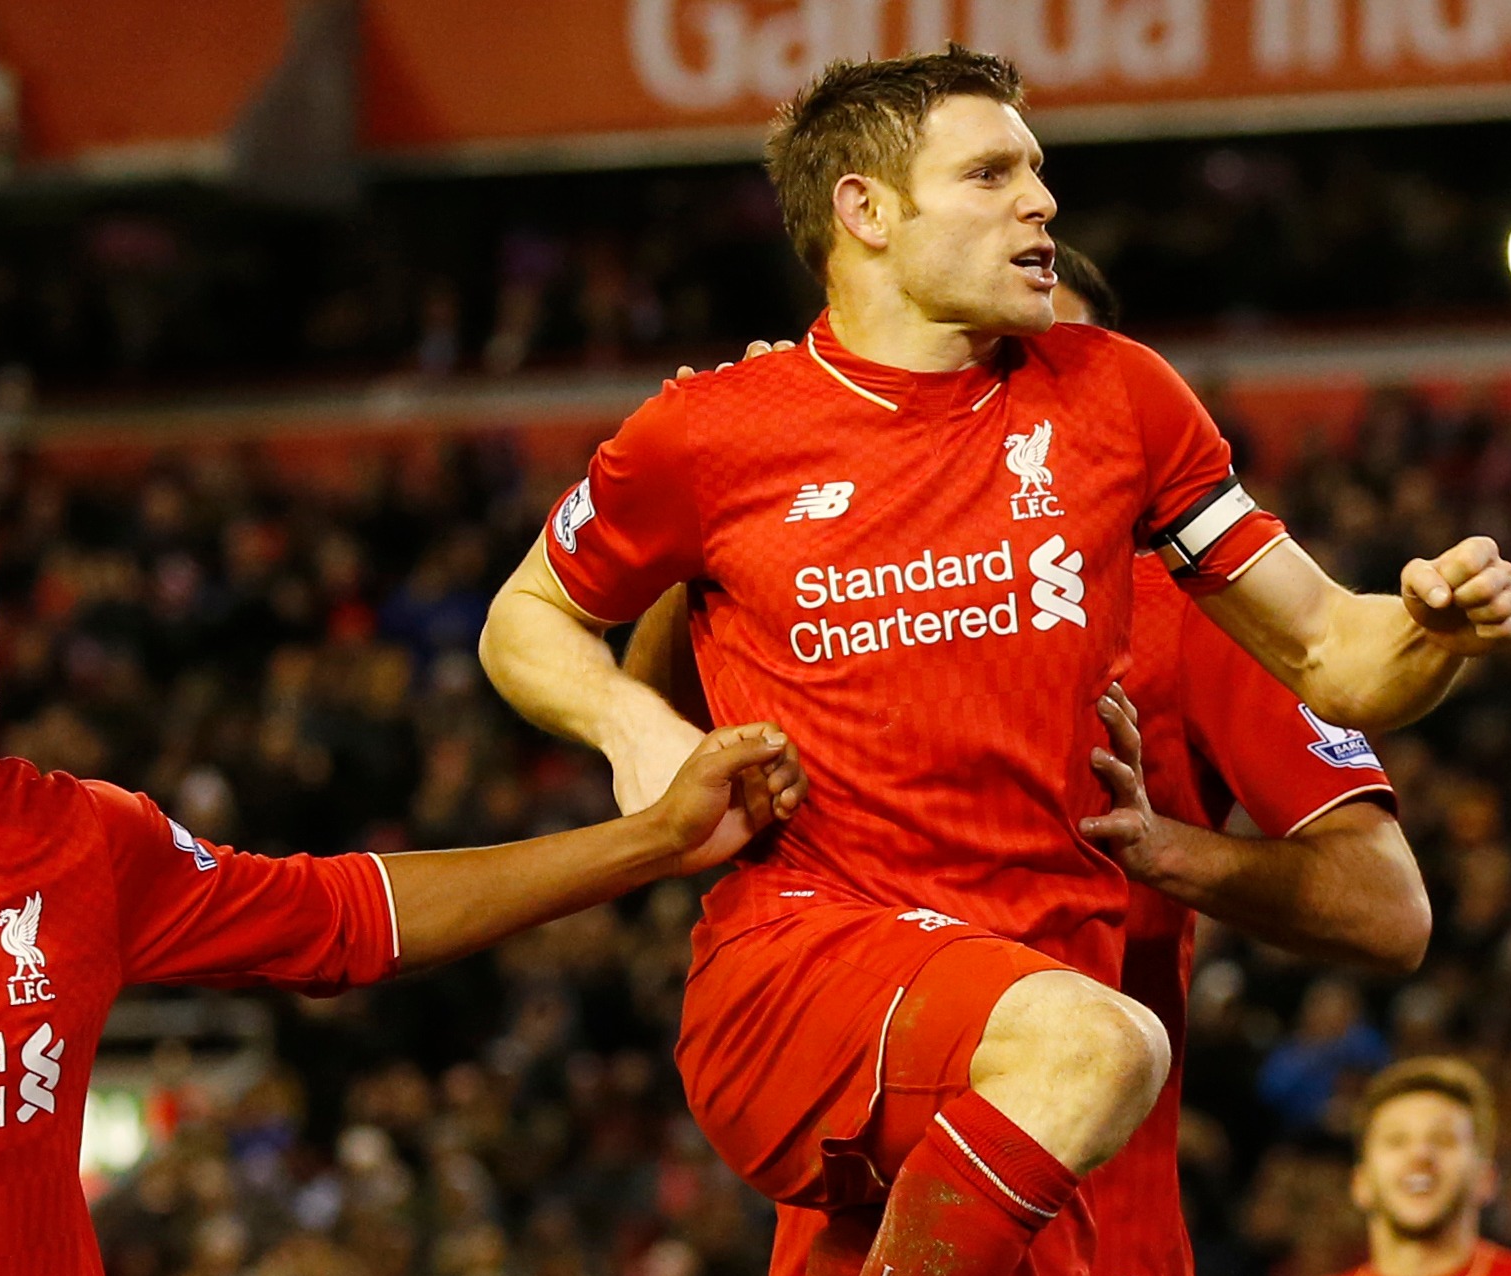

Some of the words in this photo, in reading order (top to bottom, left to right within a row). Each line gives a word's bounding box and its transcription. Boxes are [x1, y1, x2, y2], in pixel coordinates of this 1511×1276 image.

[785, 481, 855, 522] NB
[1010, 496, 1065, 521] L.F.C.
[795, 541, 1013, 609] Standard
[790, 594, 1018, 663] Chartered
[6, 979, 56, 1006] L.F.C.
